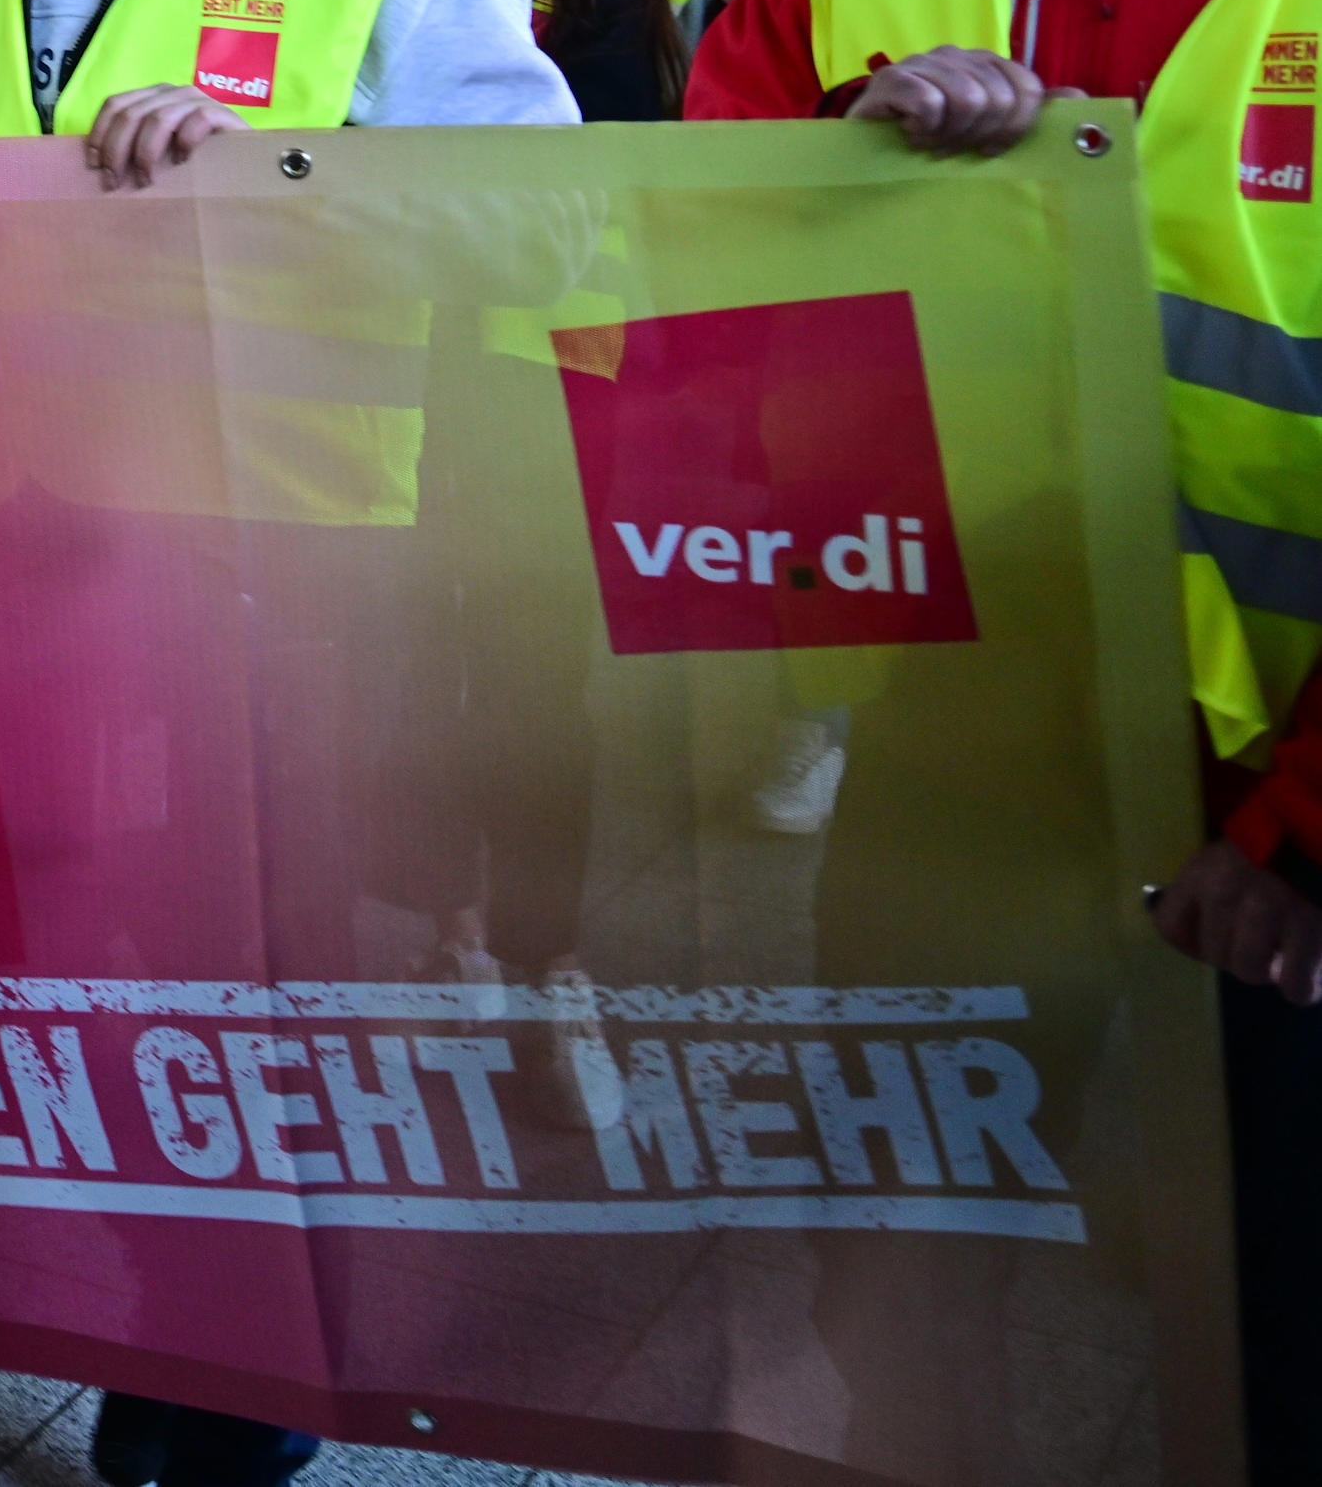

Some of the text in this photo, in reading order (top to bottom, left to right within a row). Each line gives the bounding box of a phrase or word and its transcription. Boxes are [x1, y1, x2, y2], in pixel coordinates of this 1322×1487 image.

[197, 69, 270, 100] ver.di
[1238, 161, 1306, 191] er.di
[612, 513, 930, 595] ver.di
[131, 1021, 518, 1193] GEHT
[568, 1033, 1072, 1193] MEHR
